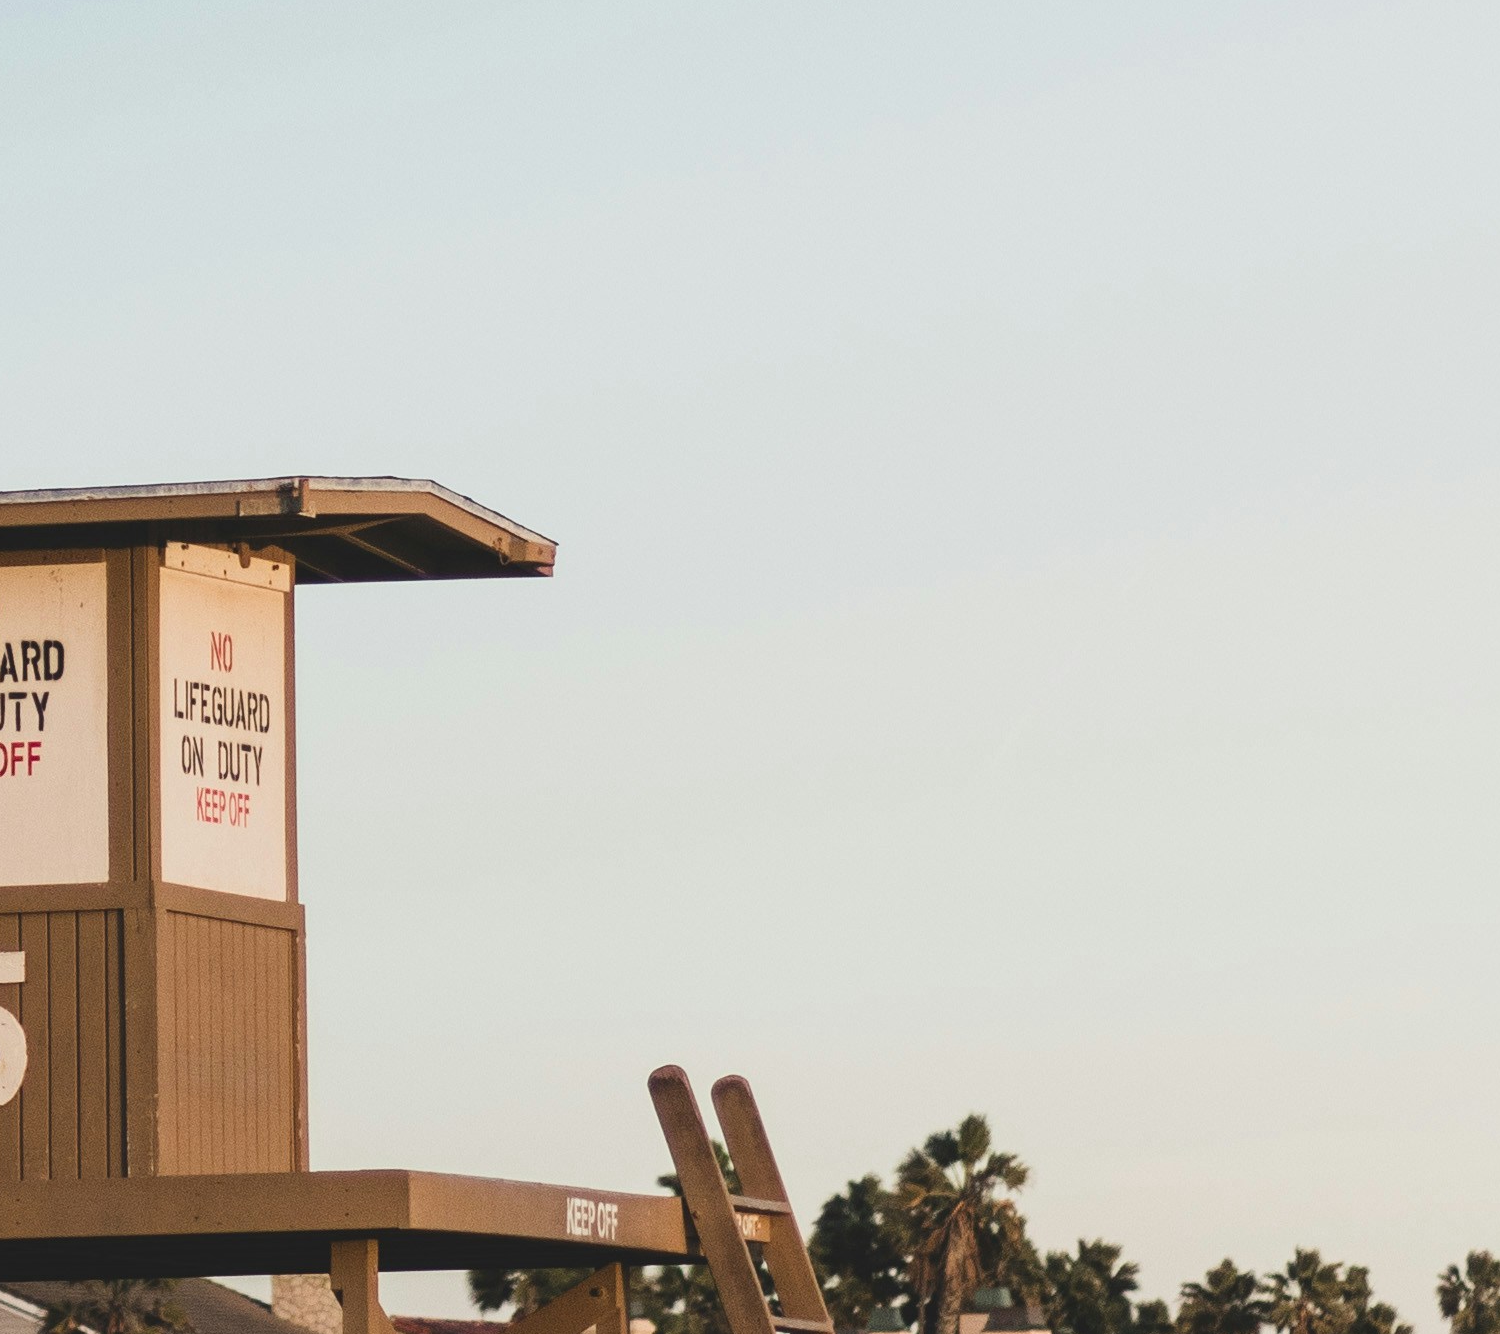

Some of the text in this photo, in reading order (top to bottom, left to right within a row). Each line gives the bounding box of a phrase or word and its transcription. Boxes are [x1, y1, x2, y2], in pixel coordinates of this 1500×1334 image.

[210, 631, 233, 673] NO
[173, 678, 270, 734] LIFEGUARD
[181, 734, 263, 787] ON DUTY
[196, 786, 250, 828] KEEP OFF
[566, 1197, 618, 1241] KEEP OFF
